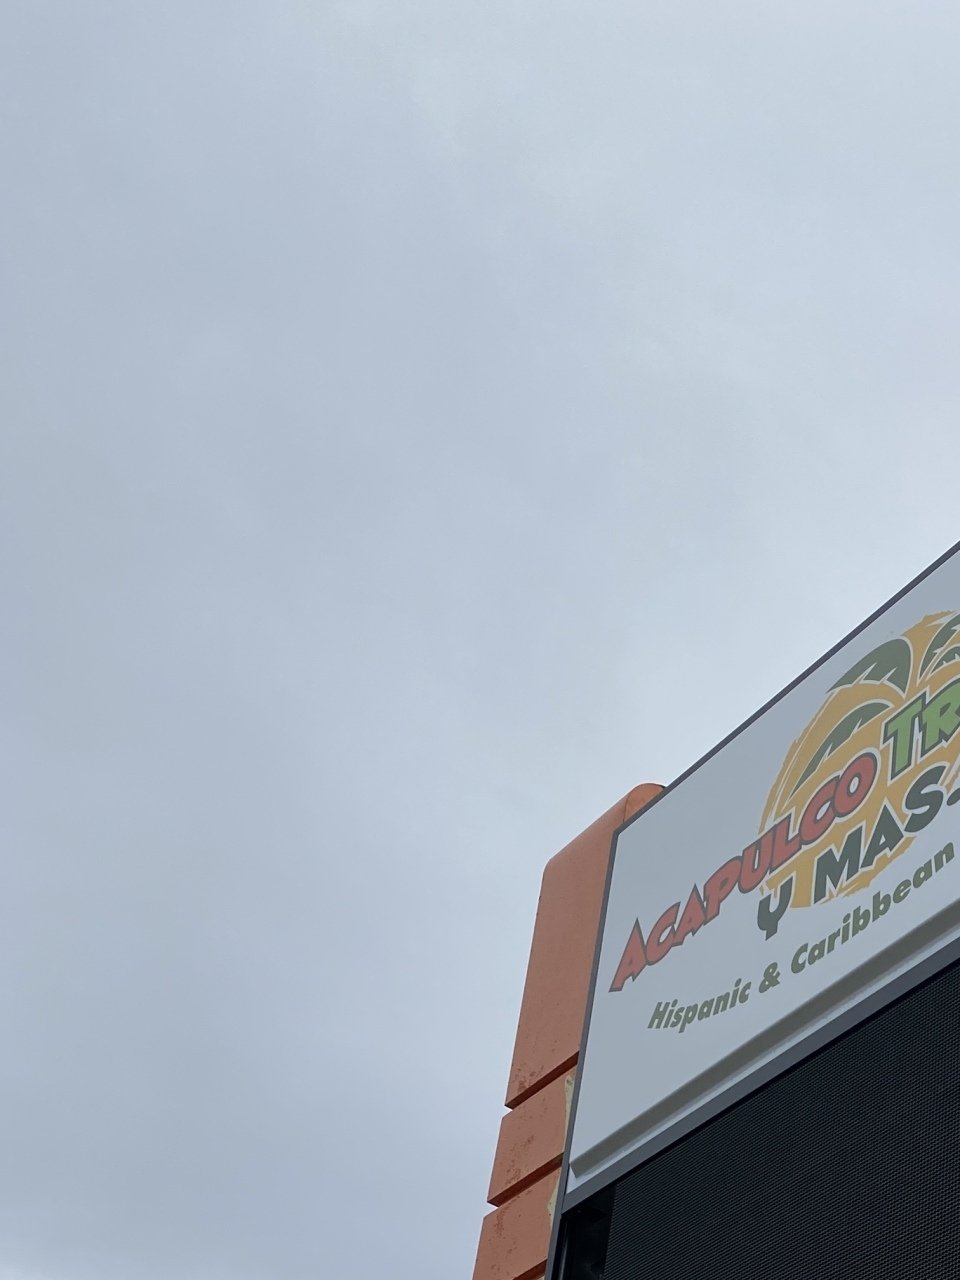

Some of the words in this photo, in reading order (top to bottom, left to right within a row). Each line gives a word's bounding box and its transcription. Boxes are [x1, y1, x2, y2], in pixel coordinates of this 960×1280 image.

[608, 752, 877, 992] ACAPULCO
[647, 978, 752, 1034] Hispanic
[758, 961, 781, 993] &
[790, 842, 955, 974] Caribbean
[757, 876, 794, 941] Y
